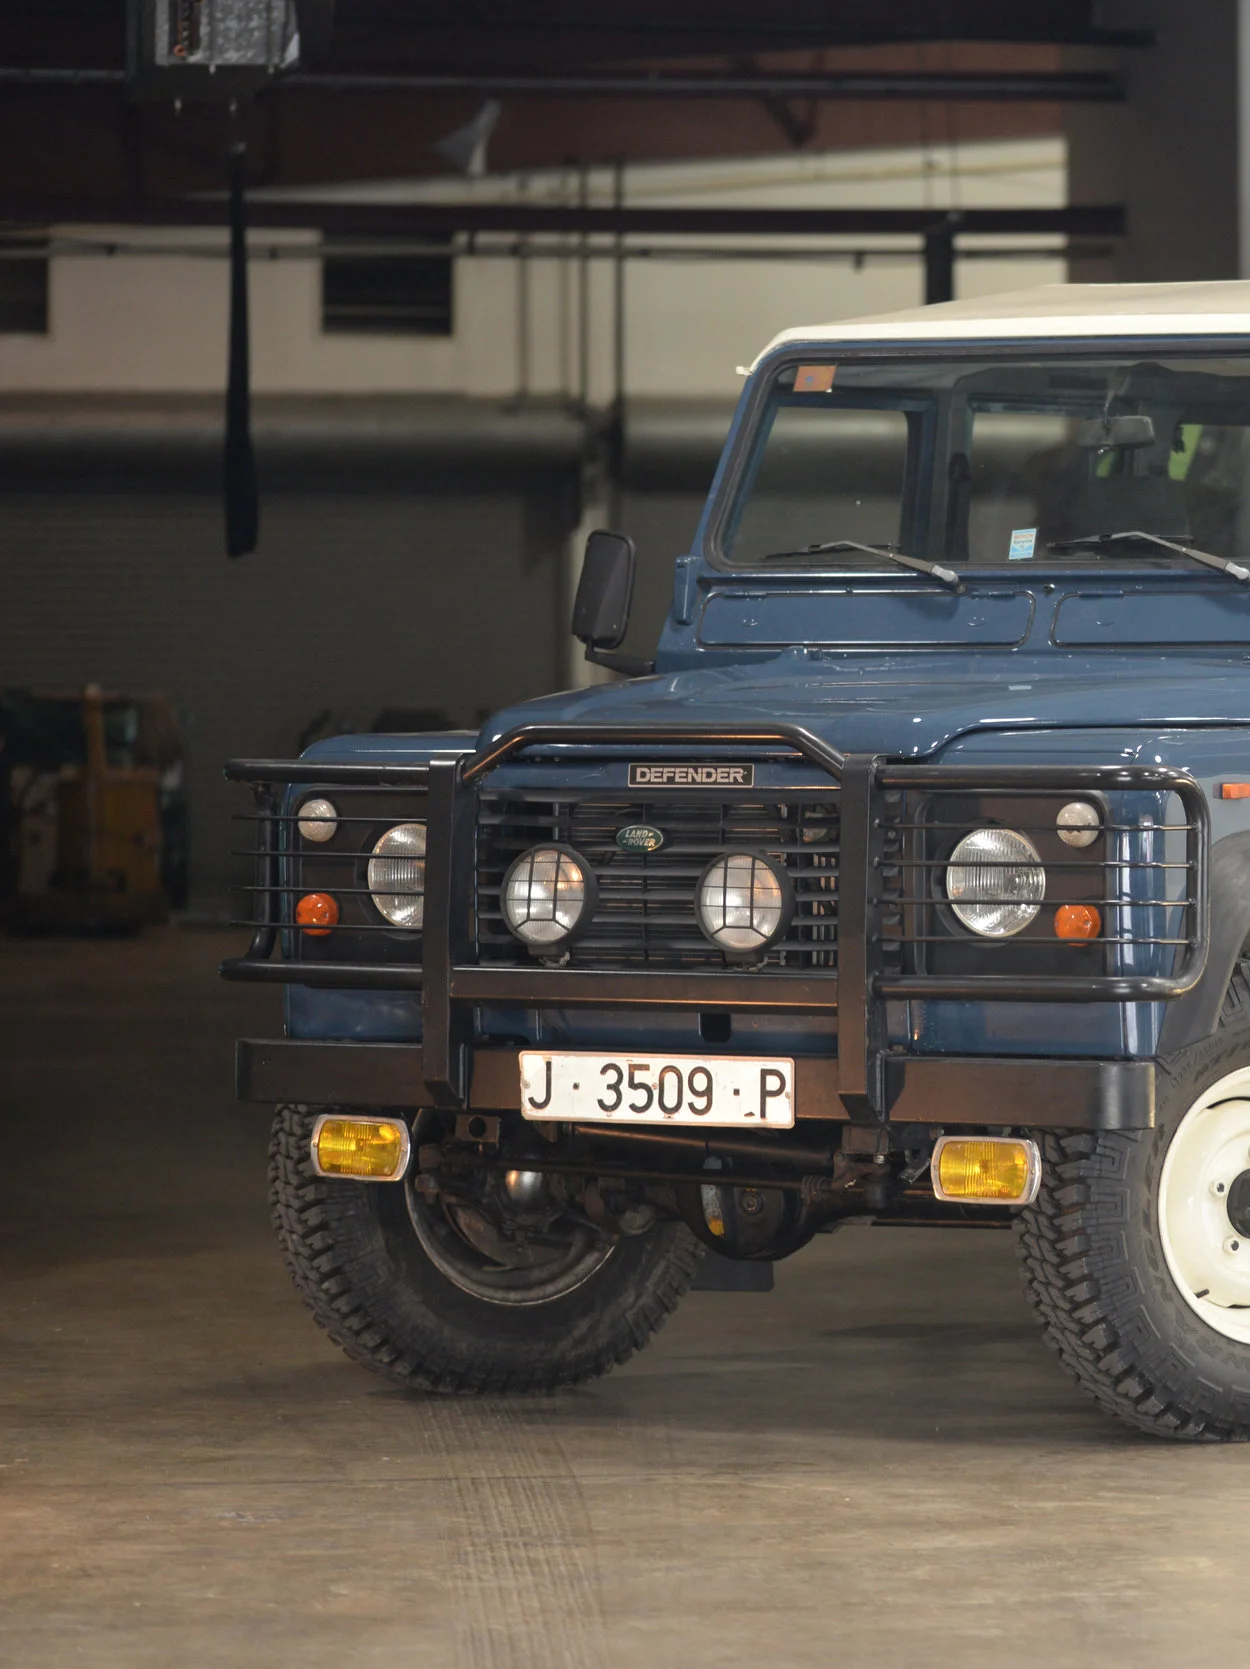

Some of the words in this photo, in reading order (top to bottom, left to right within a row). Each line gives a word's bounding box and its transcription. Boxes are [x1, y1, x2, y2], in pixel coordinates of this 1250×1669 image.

[635, 767, 744, 783] DEFENDER
[625, 829, 649, 838] LAND
[627, 837, 656, 847] ROVER
[597, 1062, 713, 1116] 3509
